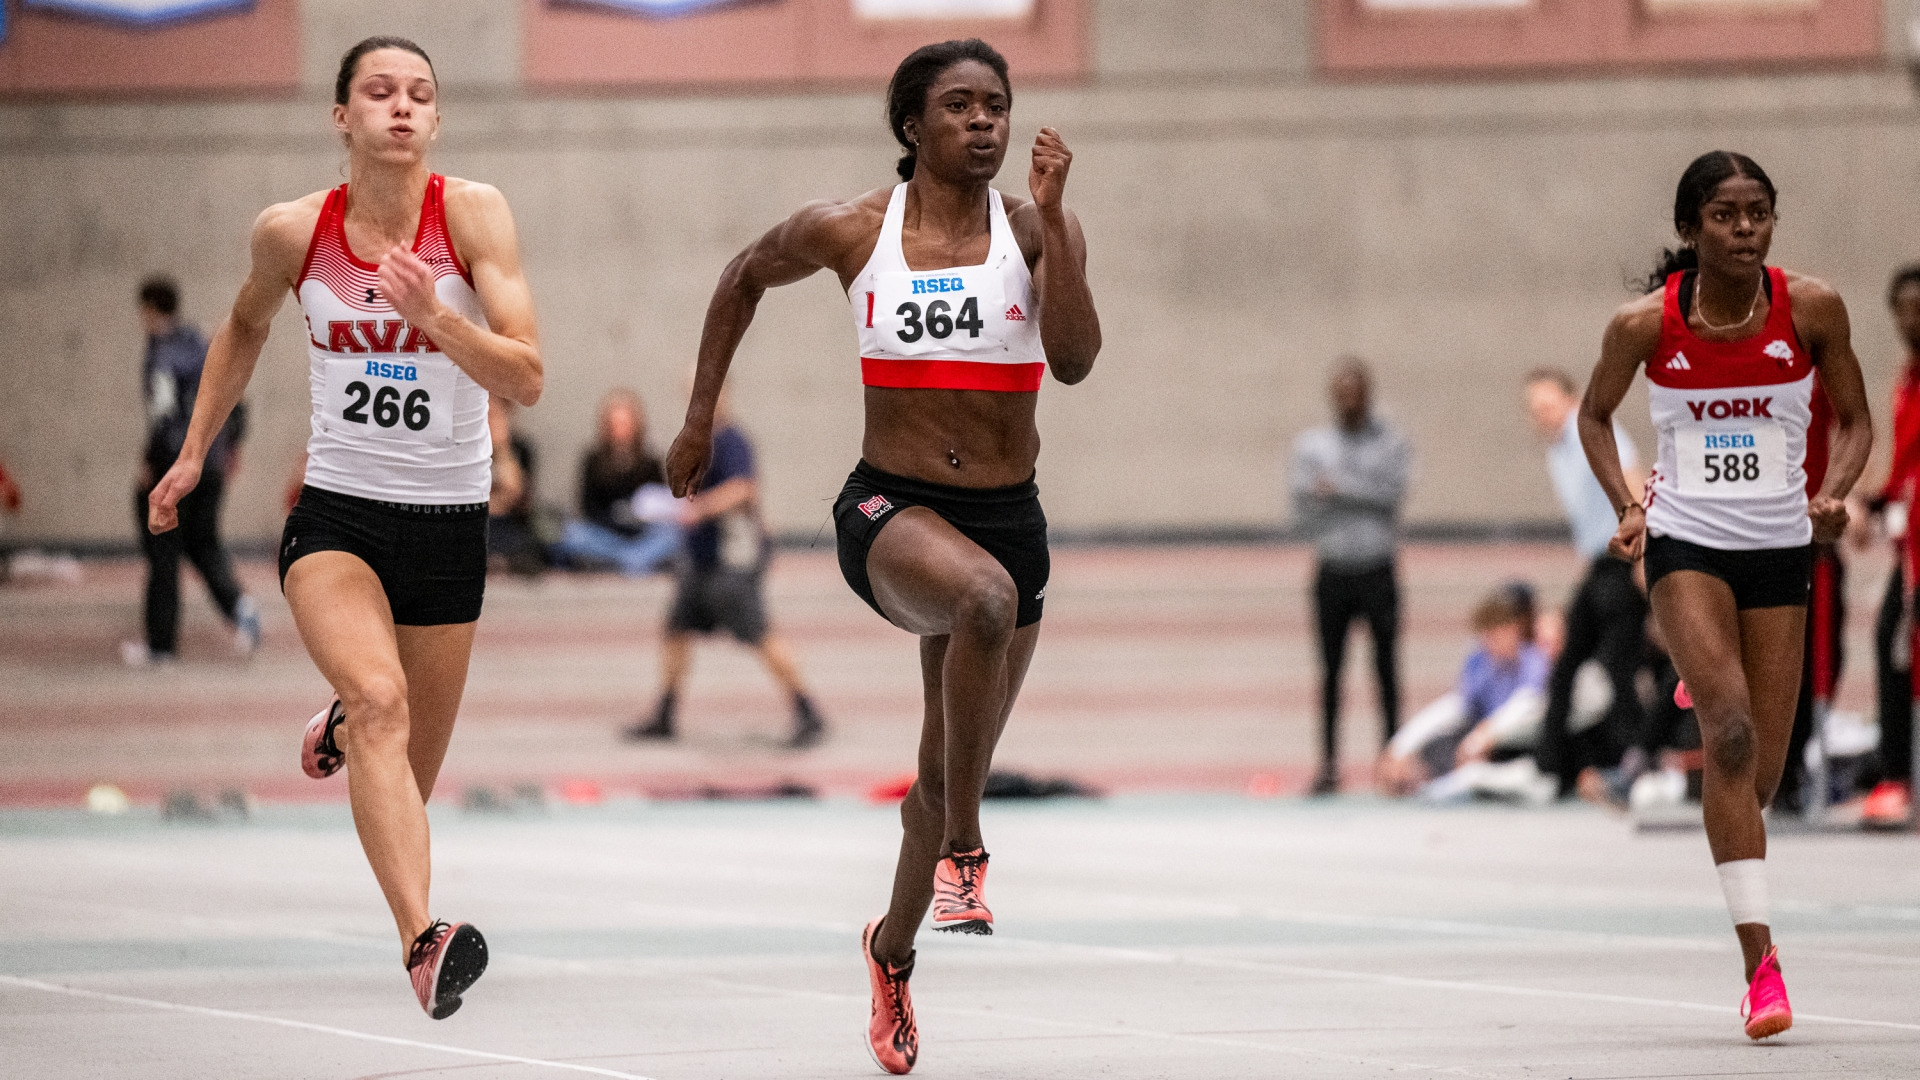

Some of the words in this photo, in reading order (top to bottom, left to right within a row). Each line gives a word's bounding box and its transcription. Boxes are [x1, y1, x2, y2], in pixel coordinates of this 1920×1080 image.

[911, 277, 965, 294] RSEQ
[896, 296, 984, 343] 364
[365, 360, 418, 381] RSEQ
[343, 381, 430, 431] 266
[1686, 396, 1773, 421] YORK
[1704, 433, 1755, 449] RSEQ
[1704, 452, 1760, 483] 588
[870, 502, 895, 521] TRACK
